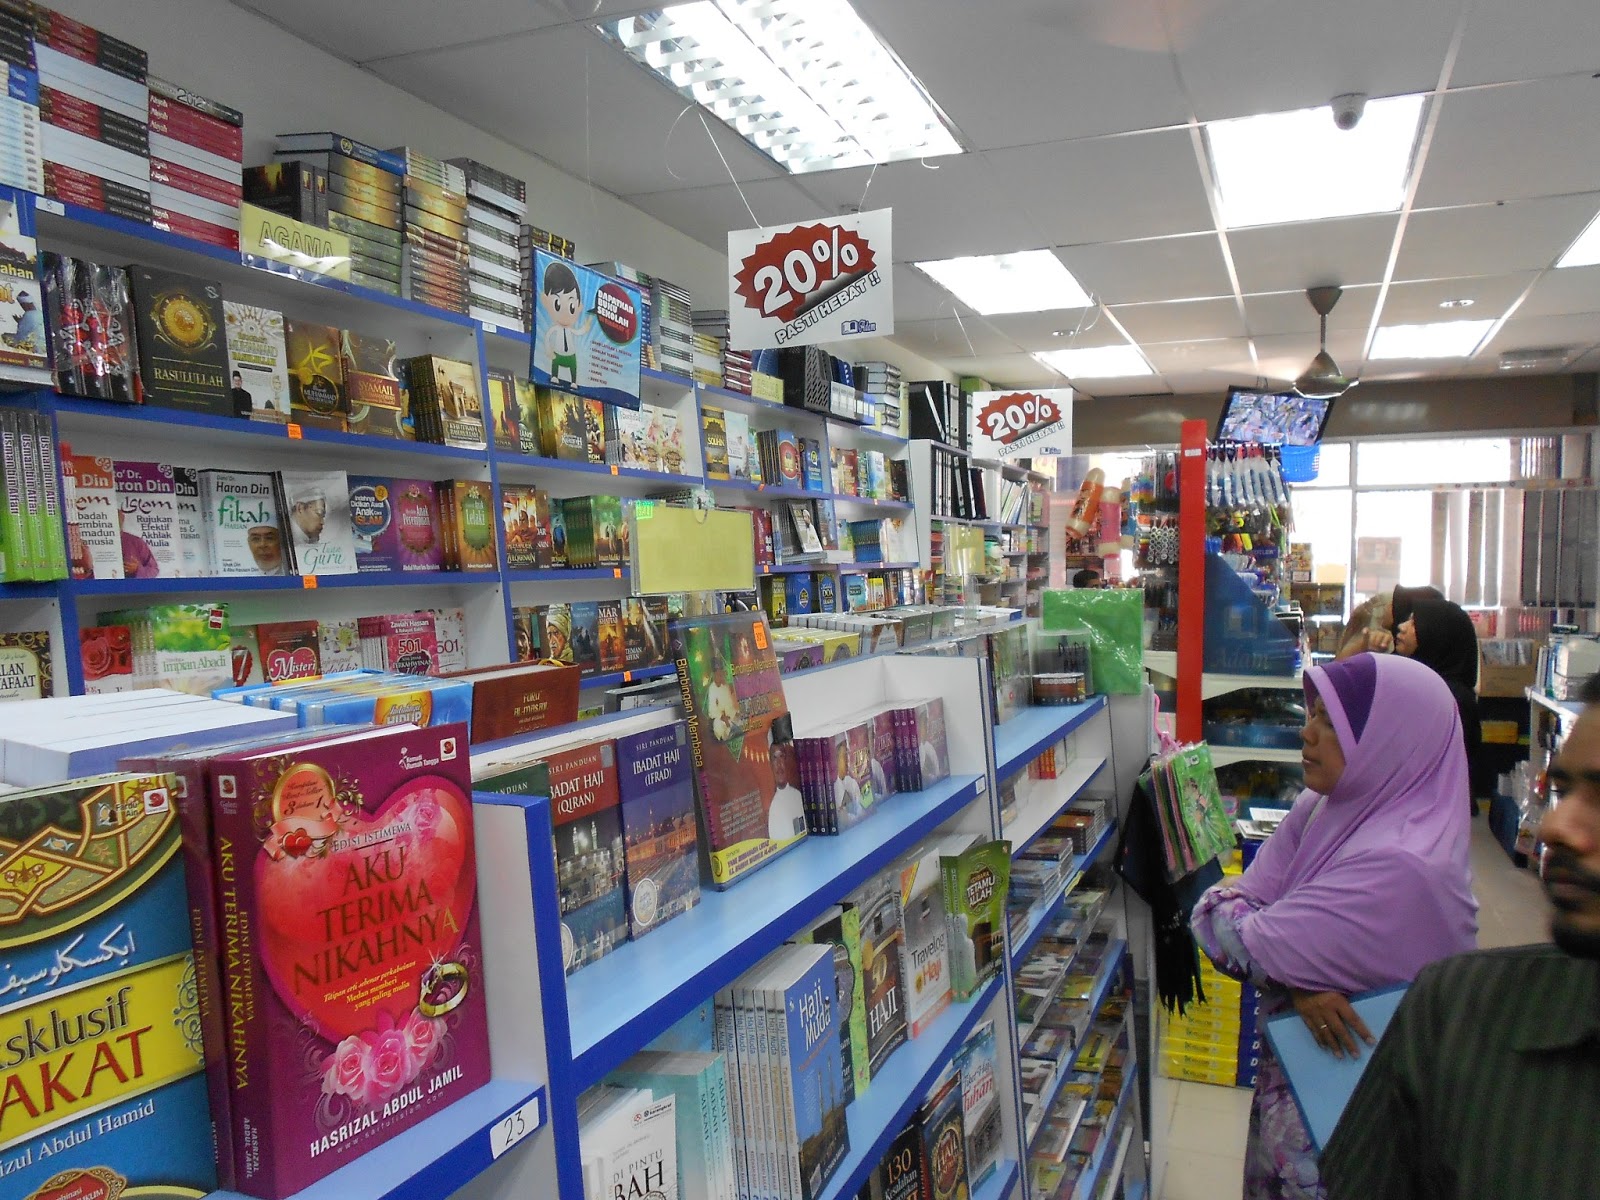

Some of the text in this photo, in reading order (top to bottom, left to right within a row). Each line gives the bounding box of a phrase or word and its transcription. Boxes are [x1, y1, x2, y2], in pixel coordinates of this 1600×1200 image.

[258, 221, 335, 258] AGAMA
[753, 228, 859, 315] 20%
[774, 309, 819, 345] PASTI
[817, 279, 867, 319] HEBAT
[153, 367, 224, 387] RASULULLAH
[360, 380, 395, 396] SYAMAIL
[987, 395, 1052, 440] 20%
[3, 432, 16, 469] Usman
[21, 434, 34, 471] Usman
[39, 436, 52, 473] Usman
[998, 441, 1028, 457] PASTI
[1026, 424, 1056, 446] HEBAT
[6, 469, 17, 488] bin
[25, 471, 36, 489] bin
[43, 473, 54, 491] bin
[82, 475, 109, 487] Din
[127, 470, 142, 479] Dr.
[146, 480, 170, 492] Din
[175, 483, 196, 495] Din
[216, 481, 269, 495] Haron Din
[136, 516, 173, 525] Rujukan
[218, 495, 270, 526] fikah
[355, 508, 374, 516] Anak
[304, 548, 346, 574] Guru
[399, 638, 422, 655] 501
[270, 656, 316, 681] Misteri
[676, 658, 703, 767] Bimbingan Membaca
[636, 734, 675, 751] SIRI PANDUAN
[565, 755, 598, 771] PANDUAN
[633, 749, 681, 774] IBADAT HAJI
[584, 771, 605, 788] HAJI
[644, 770, 672, 788] (IFRAD)
[557, 792, 596, 816] (QIRAN)
[333, 823, 413, 852] EDISI ISTIMEWA
[343, 847, 406, 896] AKU
[967, 875, 996, 898] TETAMU
[316, 878, 434, 943] TERIMA
[970, 887, 993, 909] ALLAH
[220, 836, 249, 1090] AKU TERIMA NIKAHNYA
[240, 911, 253, 1021] EDISI ISTIMEWA
[293, 907, 460, 996] NIKAHNYA
[911, 933, 945, 969] Travelog
[799, 979, 824, 1028] Haji
[869, 986, 899, 1039] HAJI
[0, 986, 132, 1070] sklusif
[805, 1005, 832, 1051] Muda
[310, 1065, 464, 1159] HASRIZAL ABDUL JAMIL
[38, 1123, 92, 1161] Abdul
[98, 1098, 155, 1136] Hamid
[503, 1110, 526, 1146] 23
[613, 1149, 663, 1184] DI PINTU
[888, 1148, 912, 1184] 130
